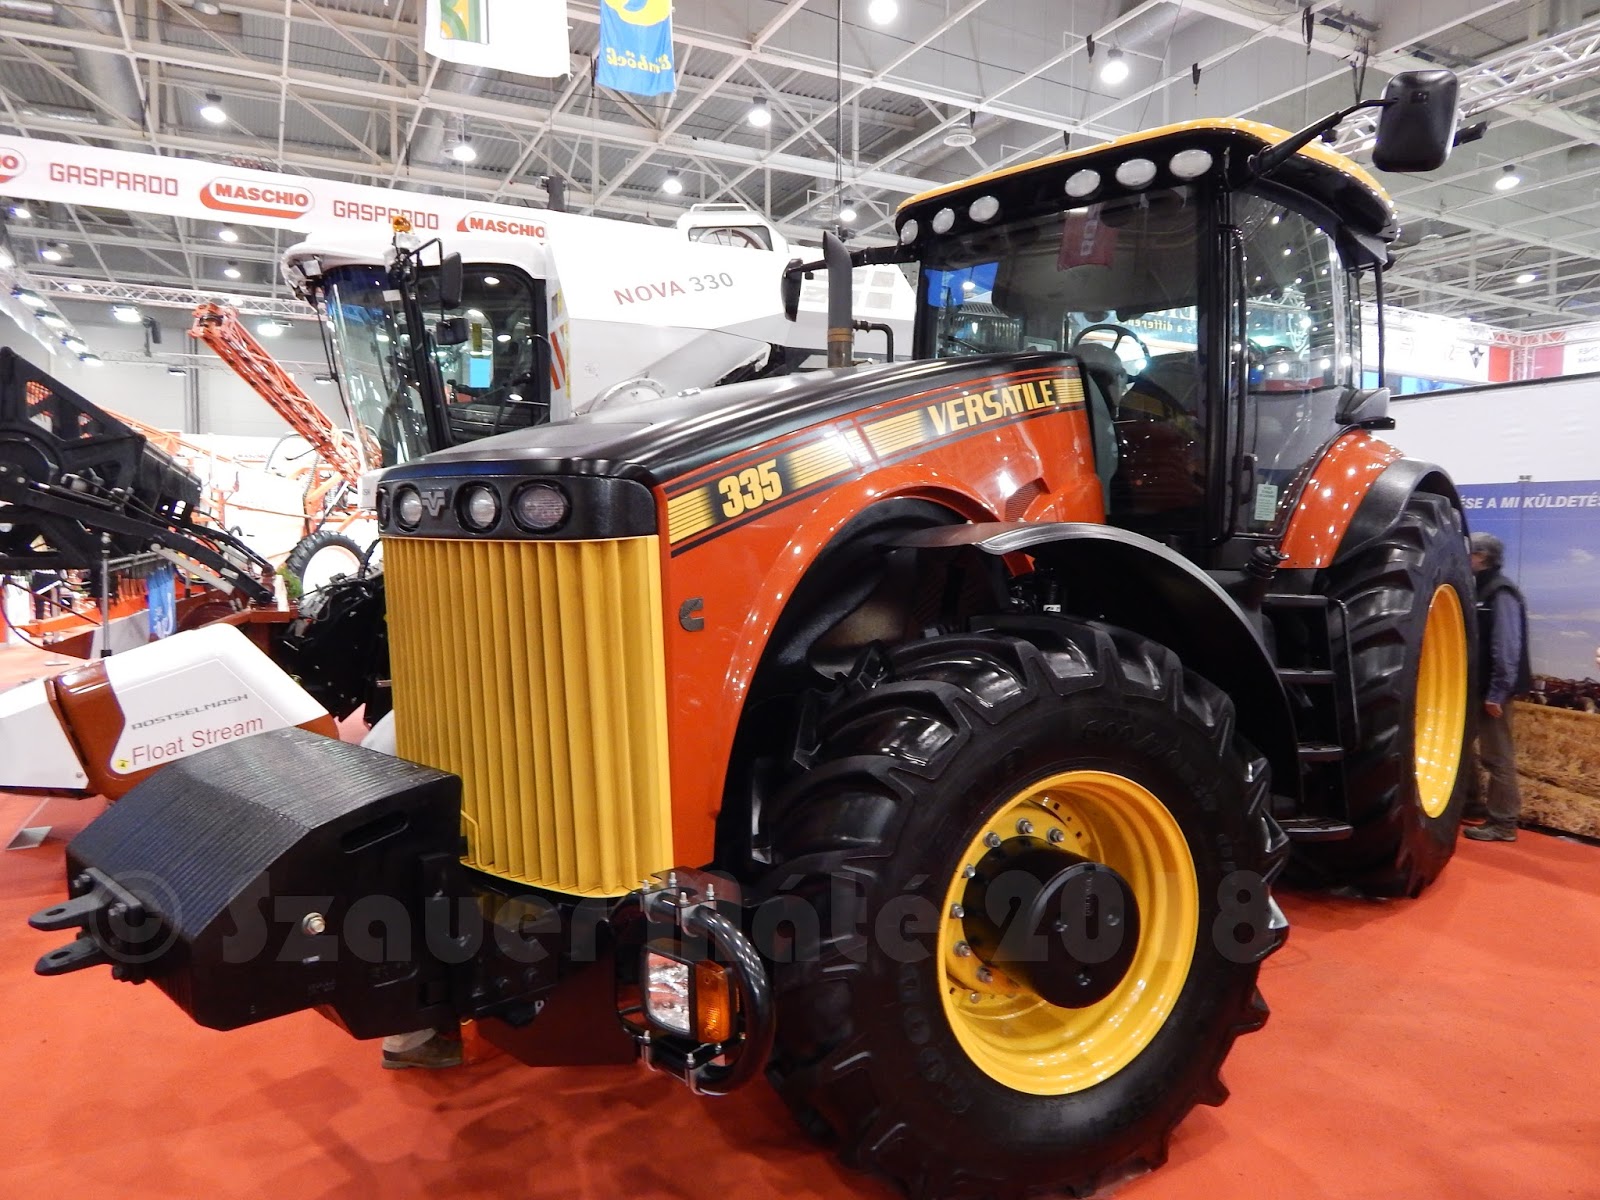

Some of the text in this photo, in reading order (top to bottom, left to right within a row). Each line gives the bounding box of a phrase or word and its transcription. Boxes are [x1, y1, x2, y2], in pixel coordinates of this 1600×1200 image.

[49, 162, 179, 197] GASPARDO
[215, 182, 309, 208] MASCHIO
[470, 217, 545, 238] MASCHIO
[613, 271, 734, 306] NOVA 330
[927, 379, 1055, 436] VERSATILE
[718, 460, 782, 517] 335
[1486, 497, 1497, 509] A
[1500, 496, 1521, 508] MI
[1522, 491, 1600, 508] KÜLDETÉ
[131, 693, 249, 730] ROSTSELMASH
[132, 717, 263, 766] Float Stream
